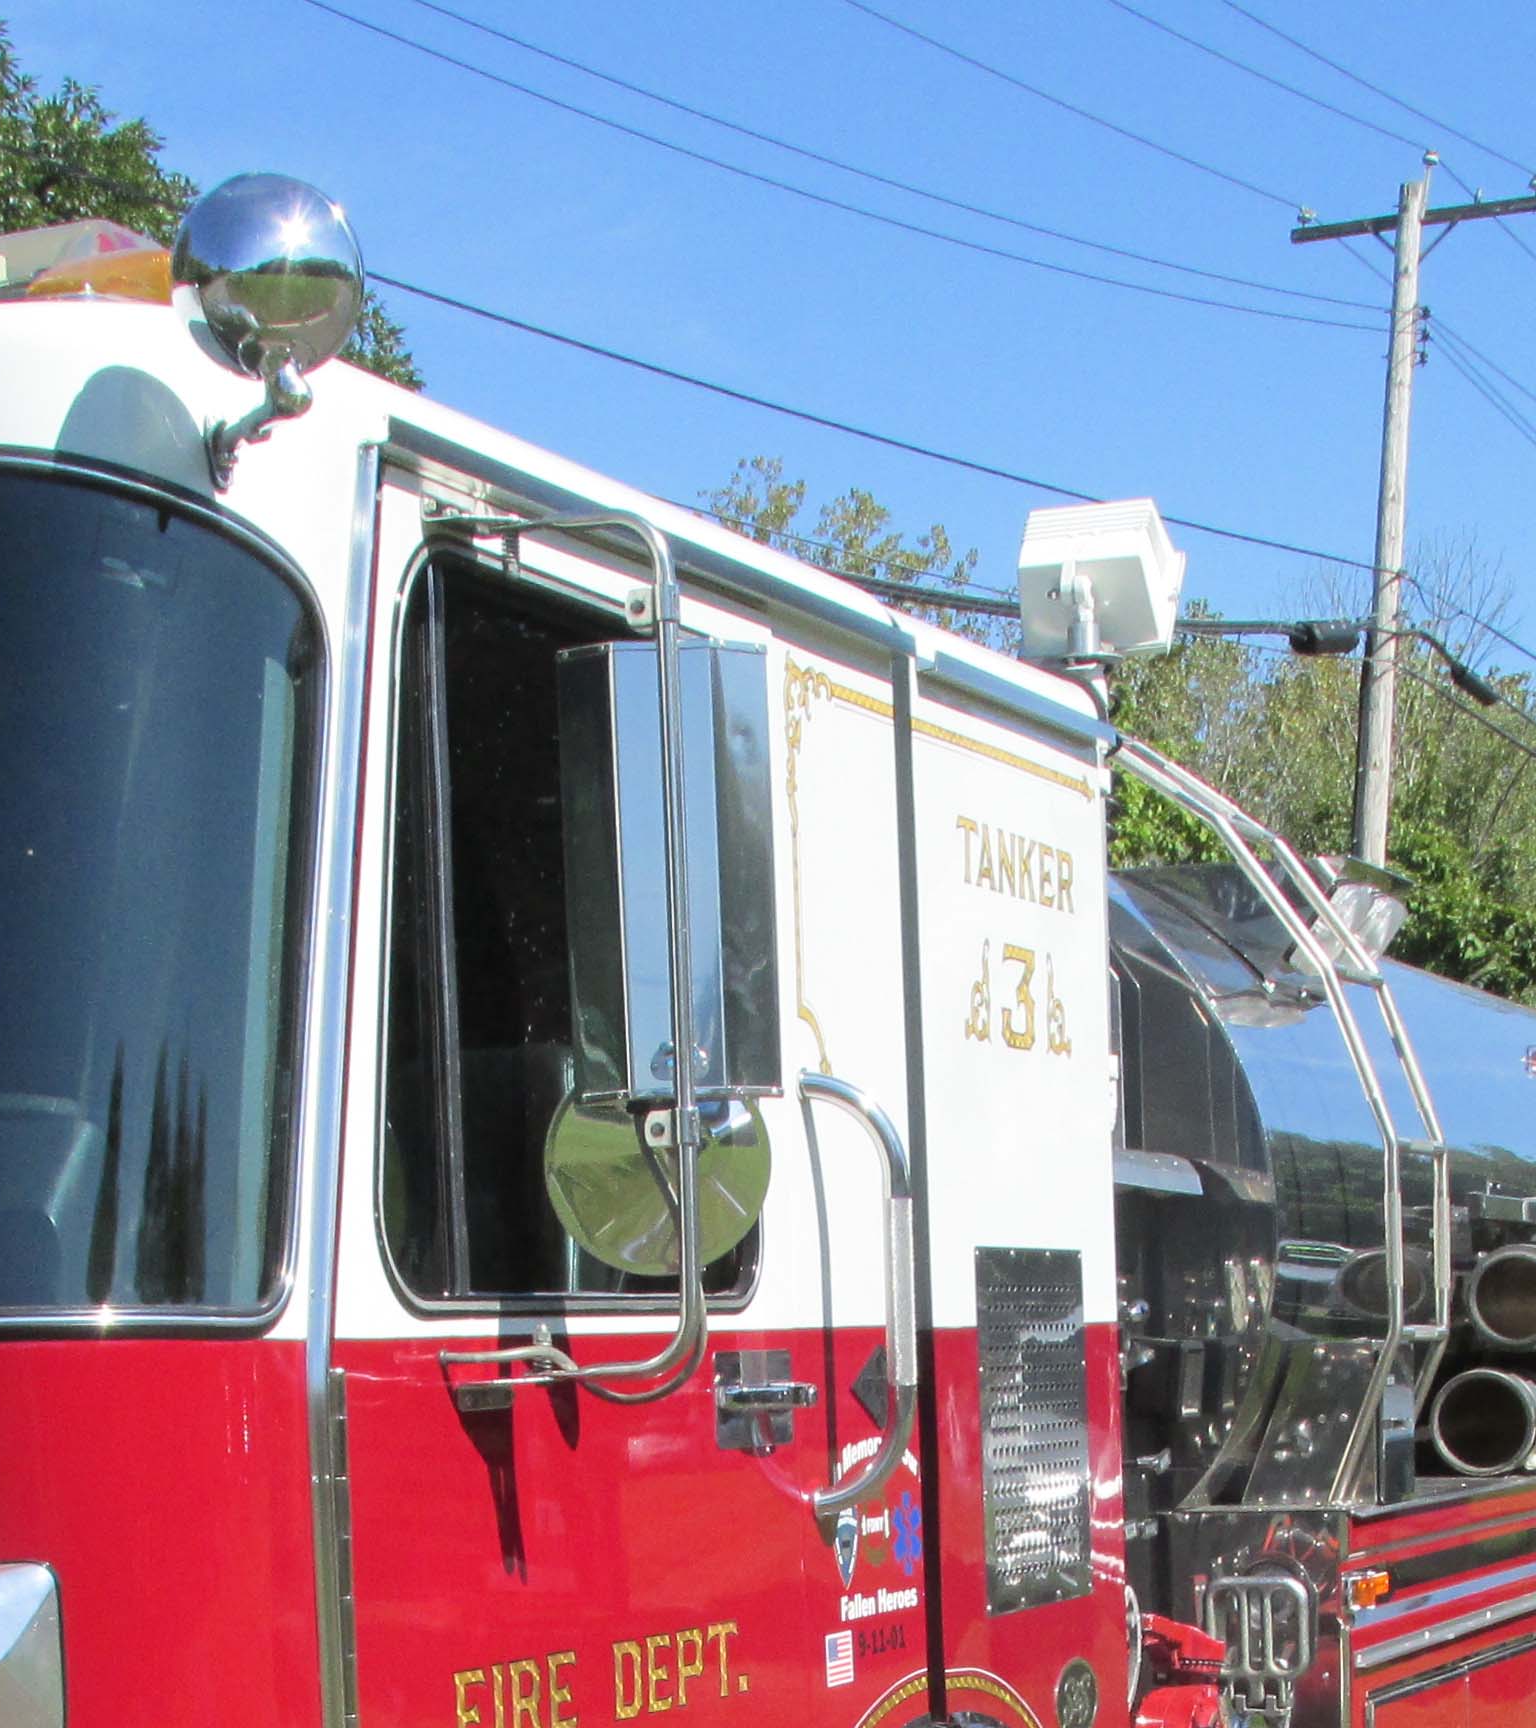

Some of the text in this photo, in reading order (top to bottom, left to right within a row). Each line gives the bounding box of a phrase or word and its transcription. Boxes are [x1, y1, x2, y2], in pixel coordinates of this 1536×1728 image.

[956, 815, 1075, 914] TANKER
[1001, 943, 1036, 1051] 3
[842, 1436, 883, 1474] Memor
[840, 1587, 919, 1622] Fallen Heroes
[612, 1619, 751, 1722] DEPT.
